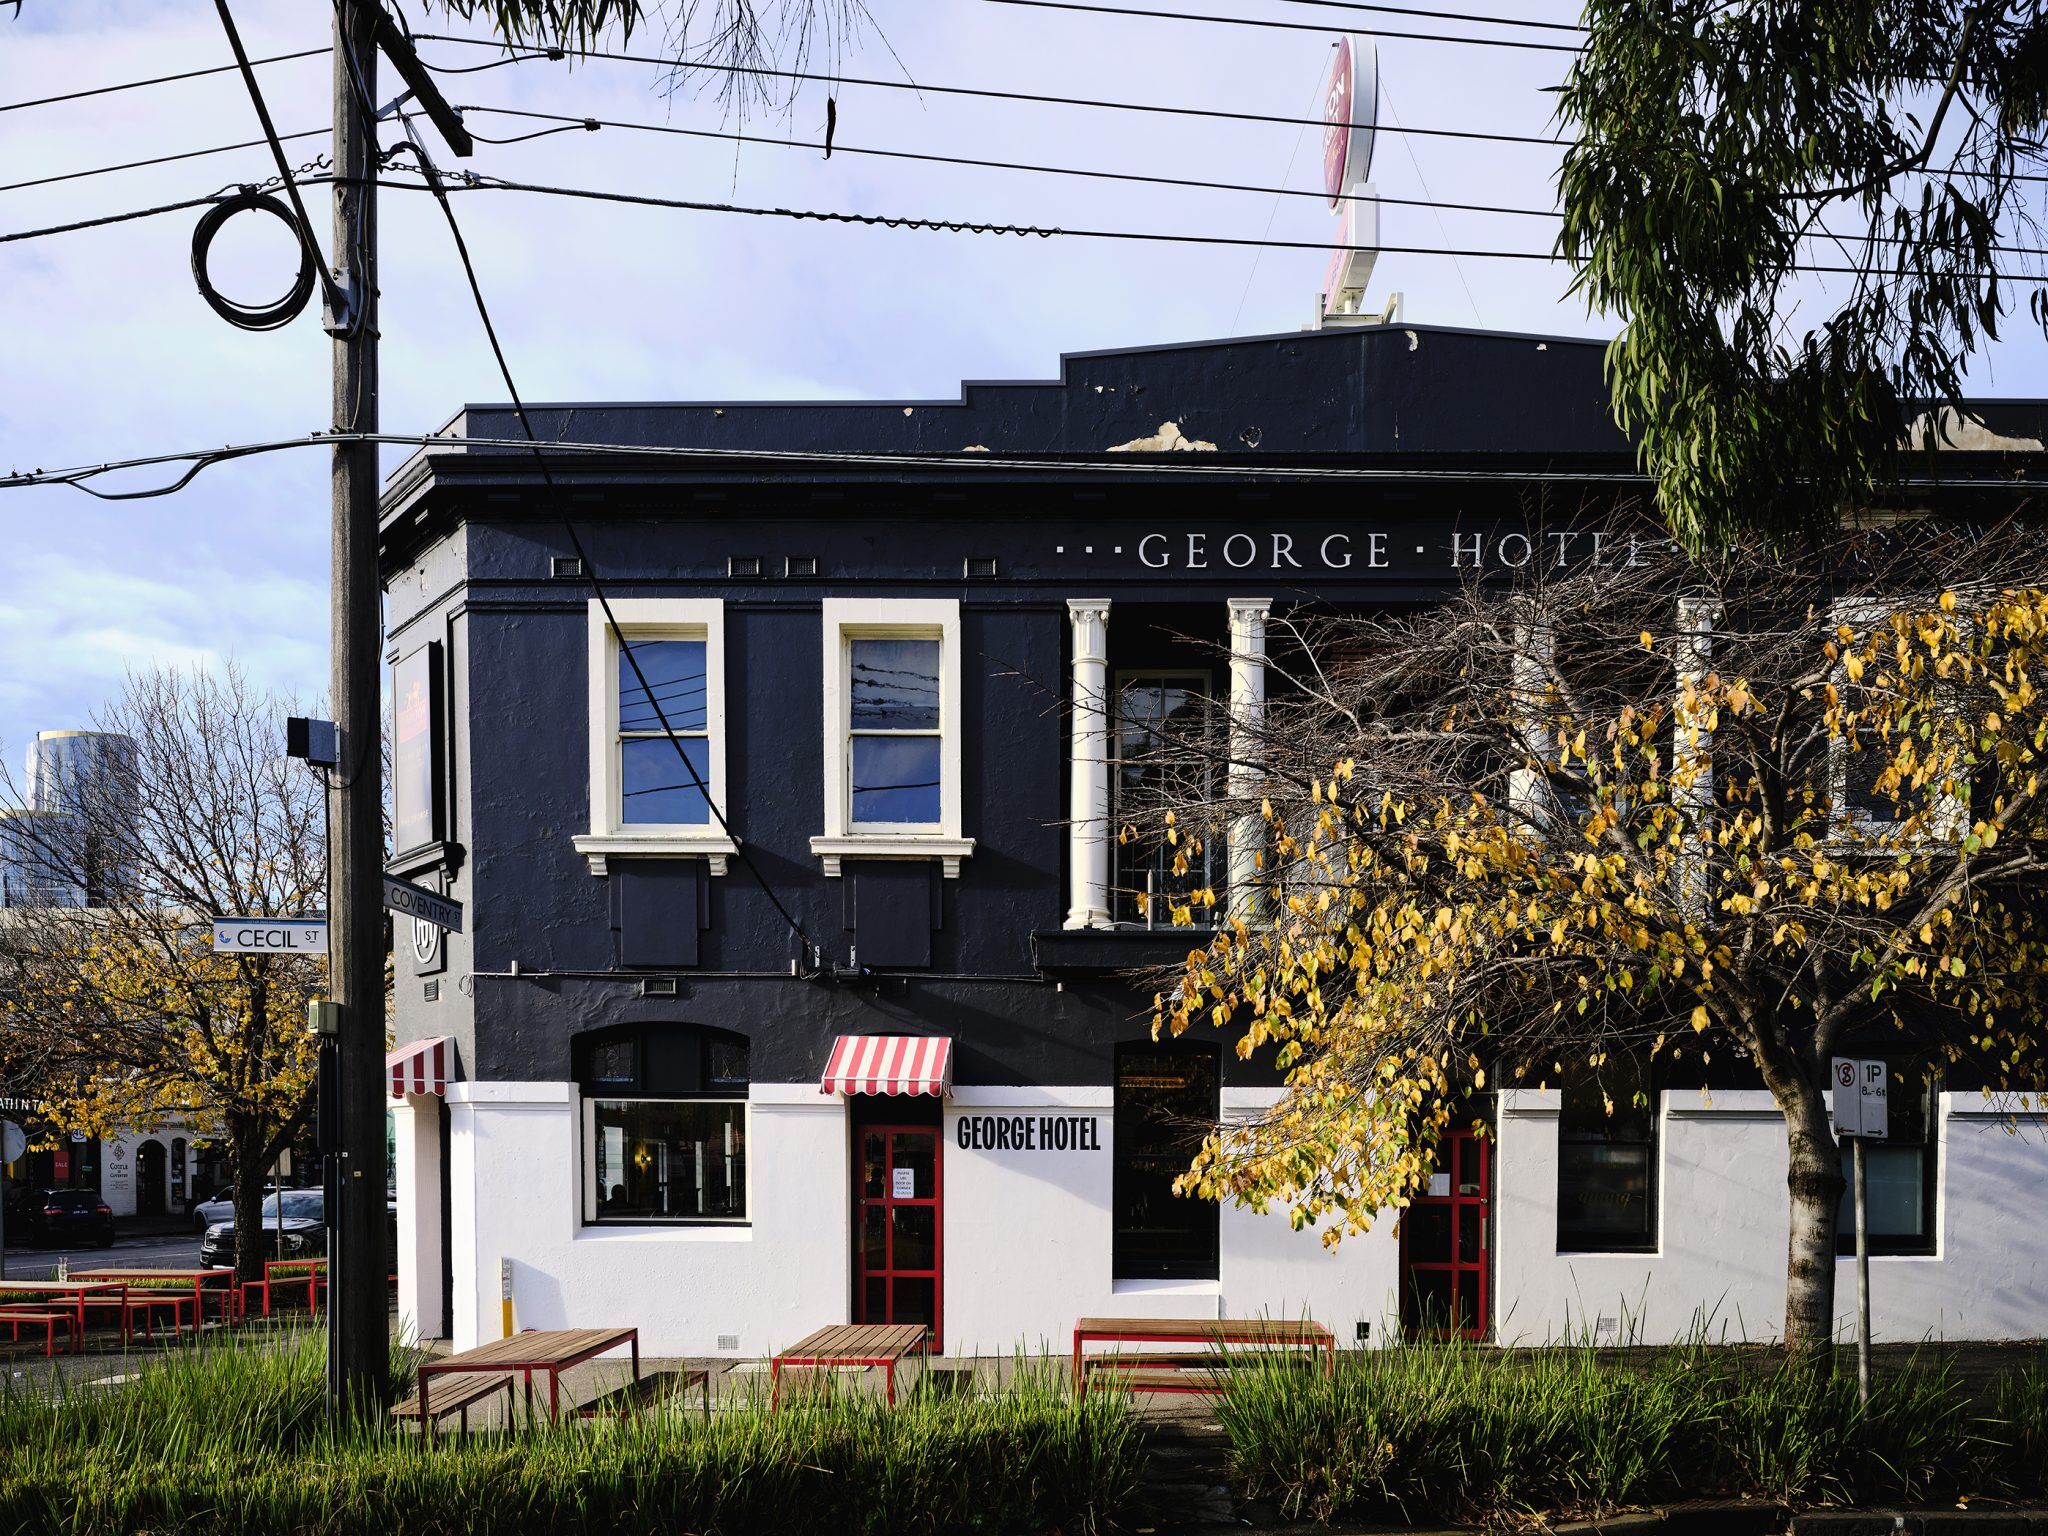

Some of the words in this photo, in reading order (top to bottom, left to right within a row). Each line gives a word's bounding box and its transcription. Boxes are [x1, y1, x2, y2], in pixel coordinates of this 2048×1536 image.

[1138, 532, 1390, 569] GEORGE
[1450, 532, 1652, 569] HOTEL
[391, 887, 452, 924] COVENTRY
[454, 910, 461, 923] ST
[237, 929, 298, 948] CECIL
[304, 930, 319, 944] ST
[1865, 1064, 1882, 1083] 1P
[957, 1115, 1036, 1151] GEORGE
[1039, 1116, 1101, 1151] HOTEL
